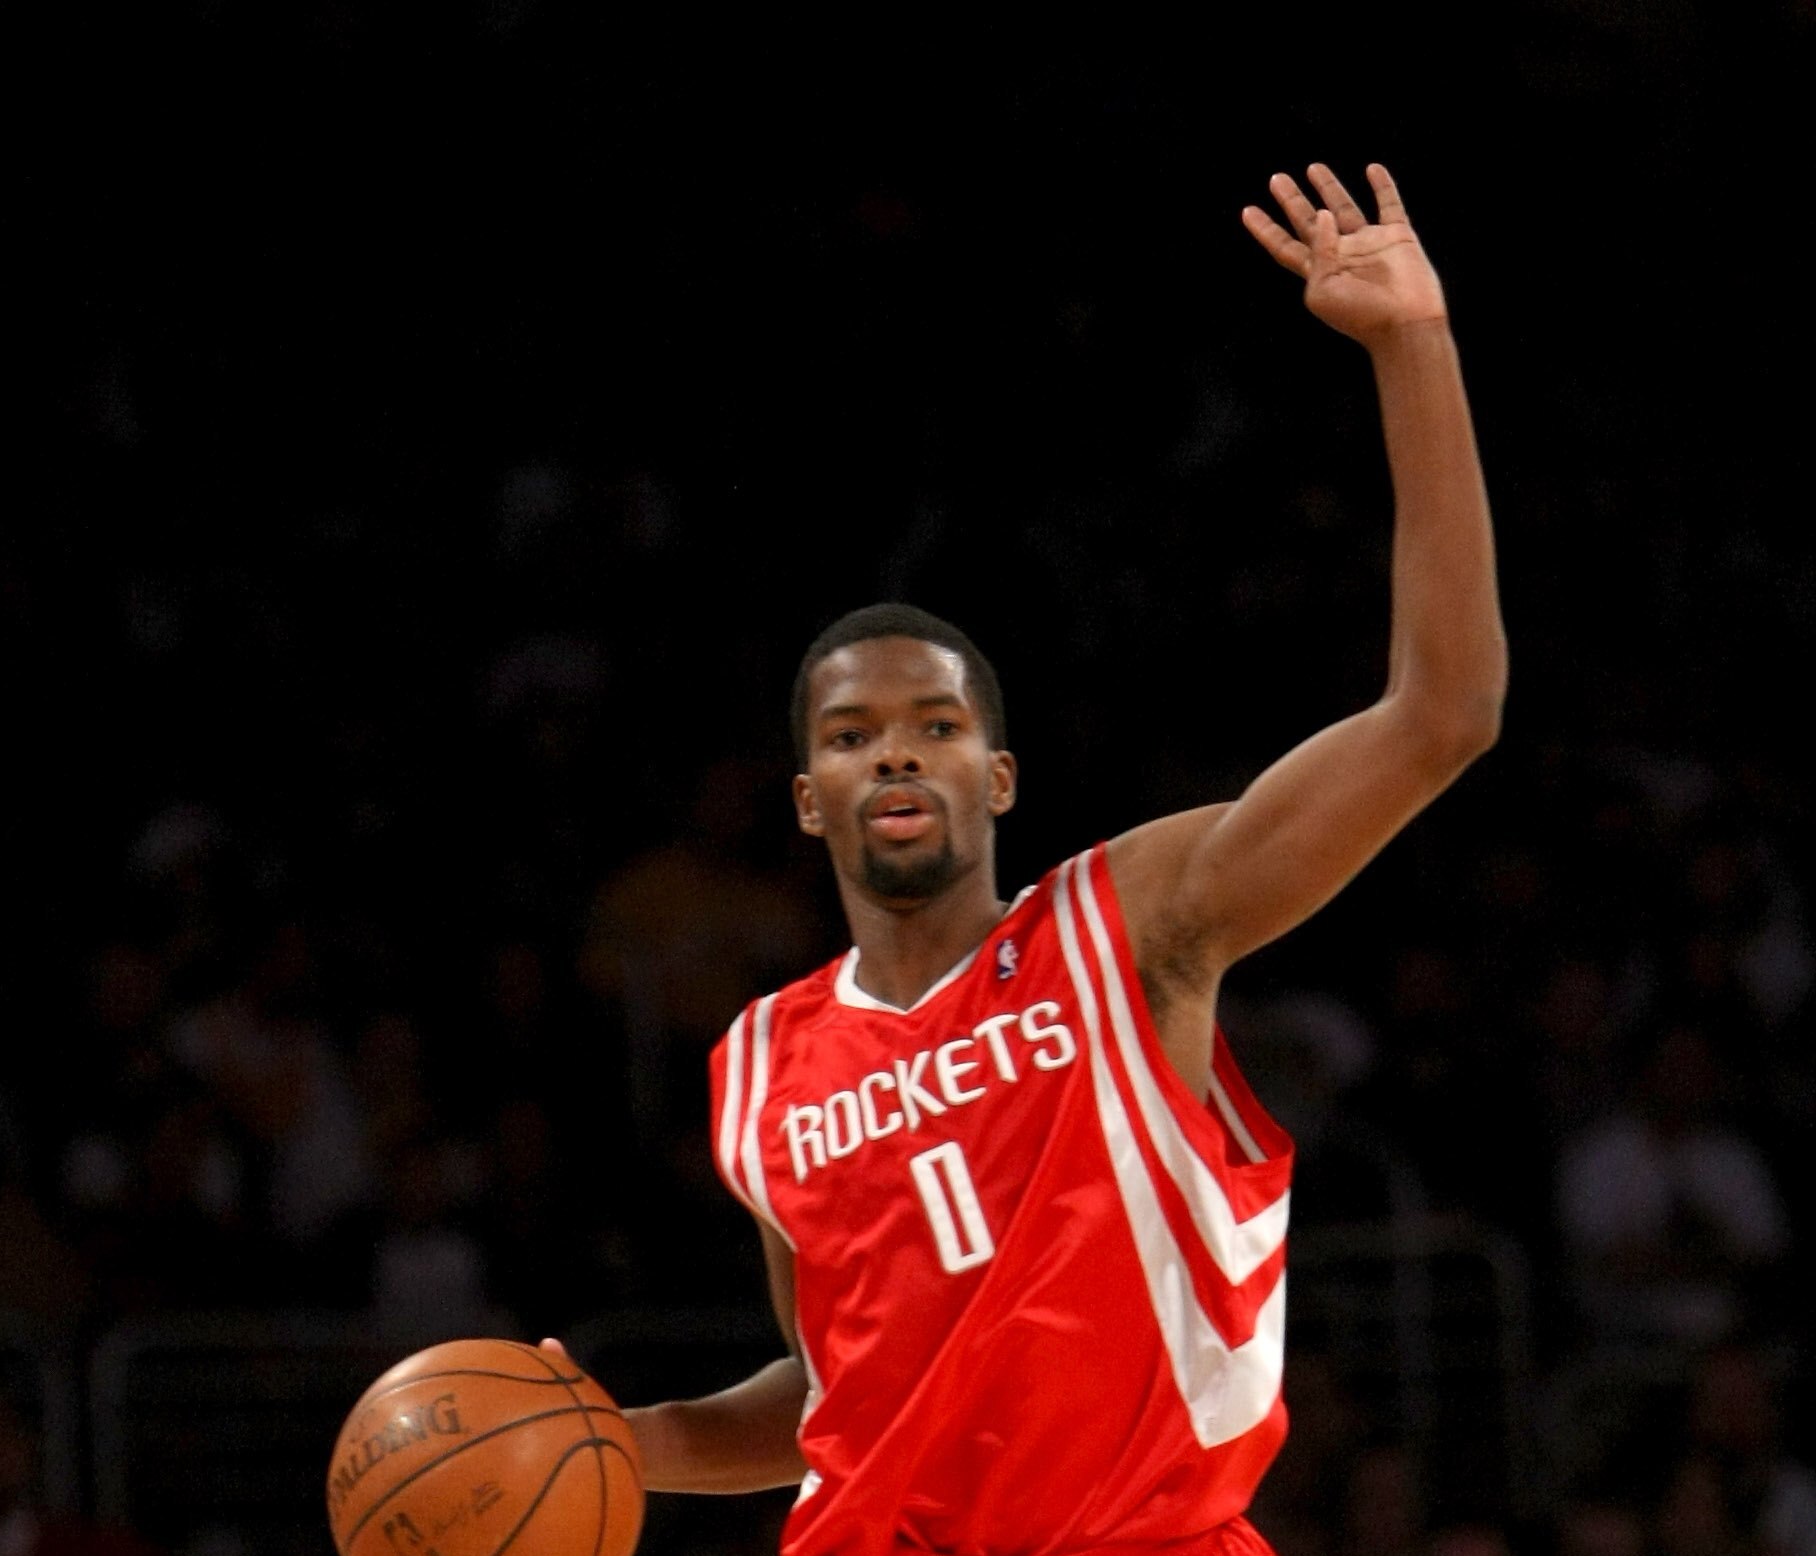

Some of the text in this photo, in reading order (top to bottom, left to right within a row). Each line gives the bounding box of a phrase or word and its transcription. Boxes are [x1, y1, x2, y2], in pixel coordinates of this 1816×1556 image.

[781, 1001, 1077, 1184] ROCKETS
[909, 1141, 995, 1274] 0
[331, 1393, 461, 1505] ALDING
